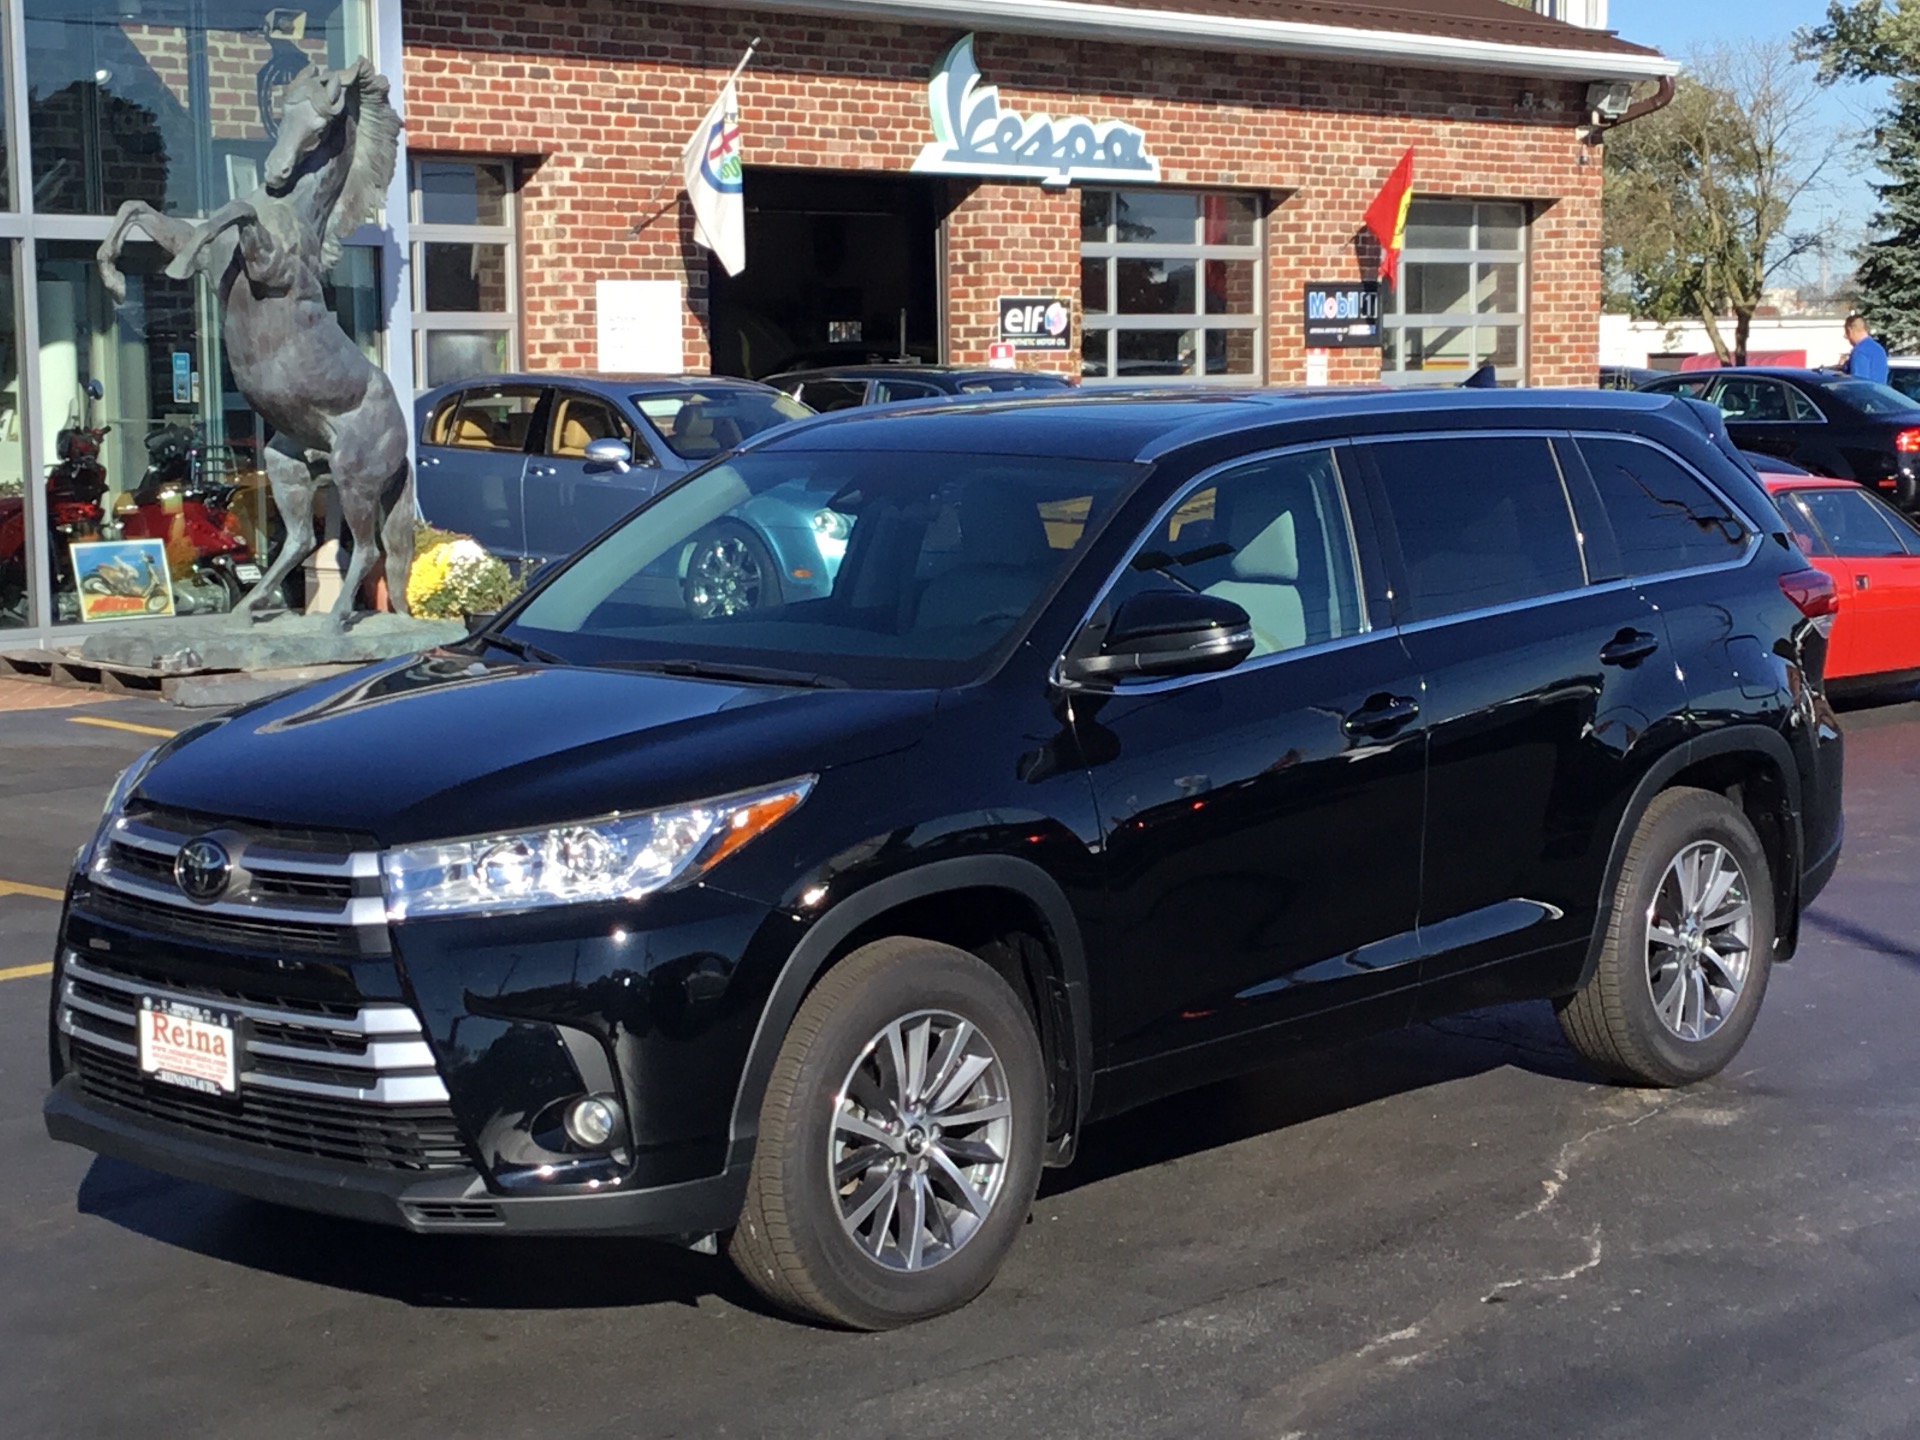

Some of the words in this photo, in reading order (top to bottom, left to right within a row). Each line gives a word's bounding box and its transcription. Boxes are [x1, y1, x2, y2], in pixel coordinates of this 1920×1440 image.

[931, 34, 1153, 175] Vespa
[1004, 305, 1045, 333] elf
[1309, 291, 1358, 318] Mobil
[151, 1011, 227, 1057] Reina
